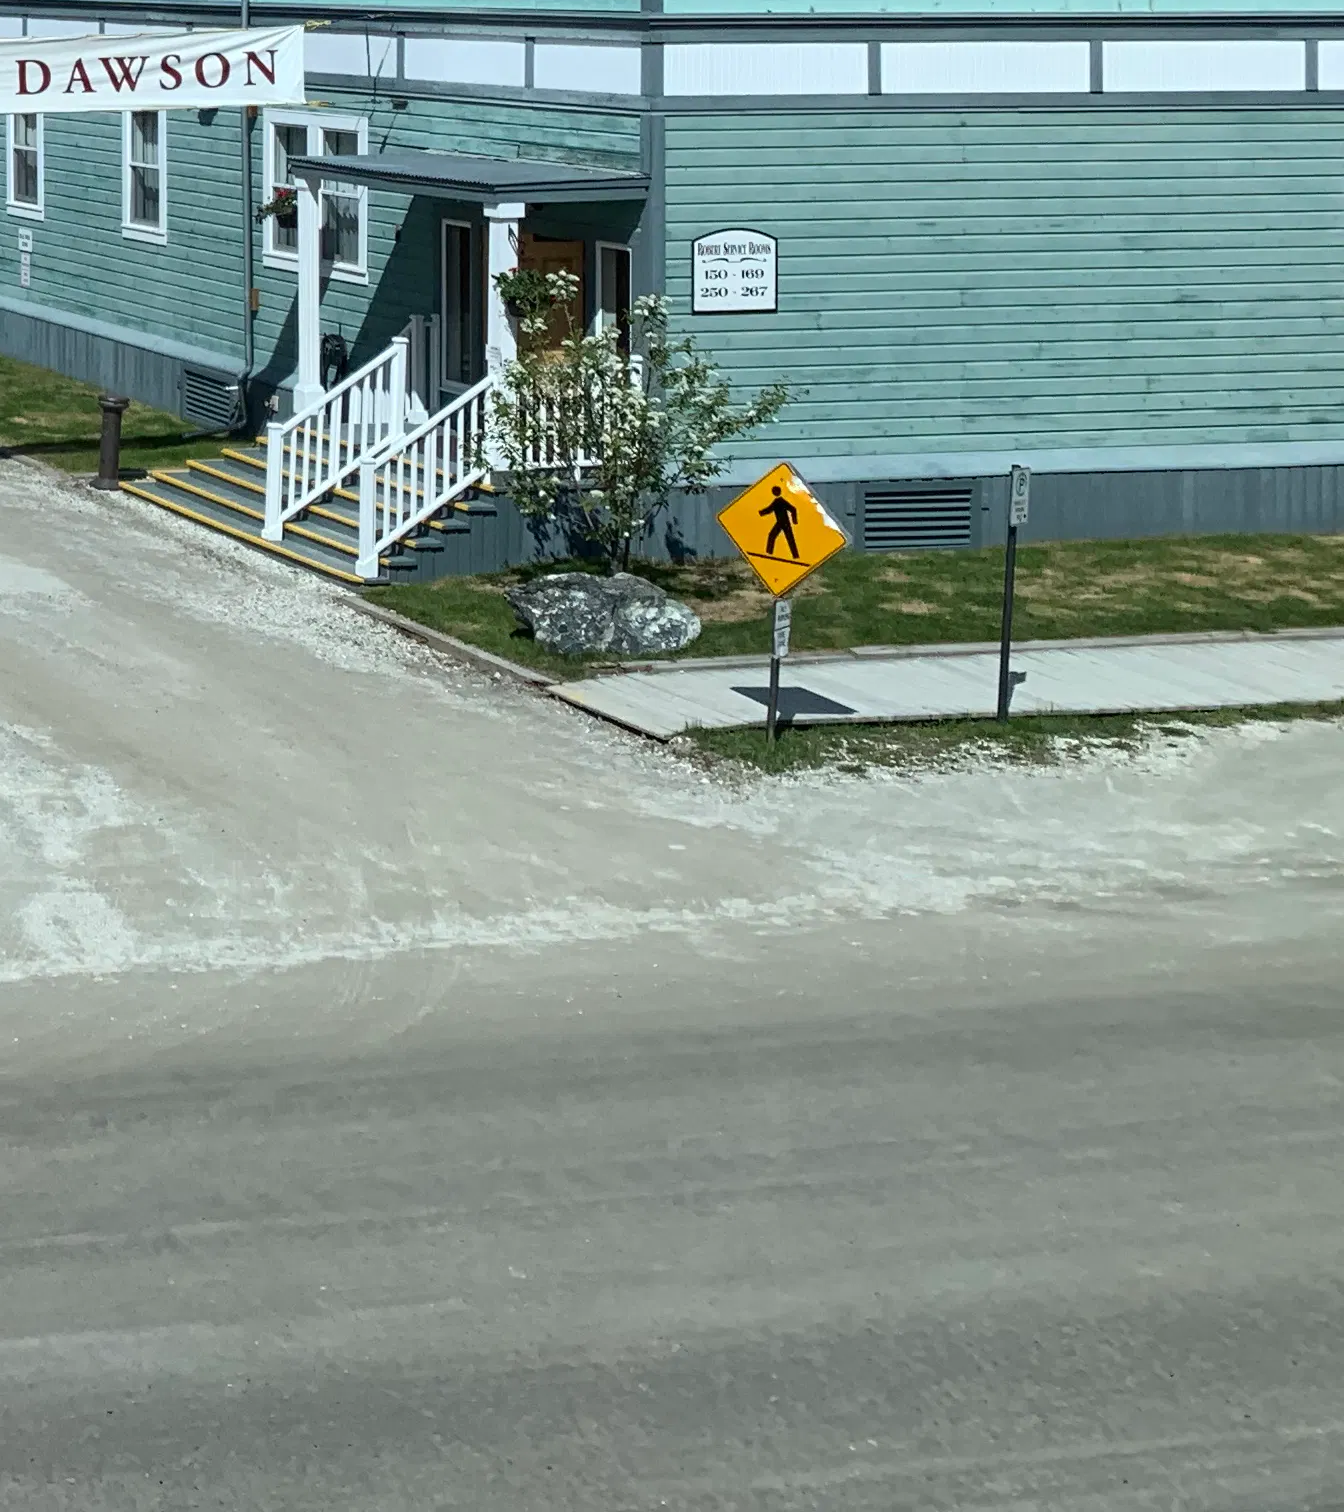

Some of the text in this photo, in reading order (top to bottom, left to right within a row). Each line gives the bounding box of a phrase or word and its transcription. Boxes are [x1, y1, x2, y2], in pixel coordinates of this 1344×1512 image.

[15, 48, 279, 95] DAWSON
[704, 269, 728, 280] 150
[741, 269, 764, 279] 169
[700, 287, 728, 298] 250
[740, 286, 768, 297] 267
